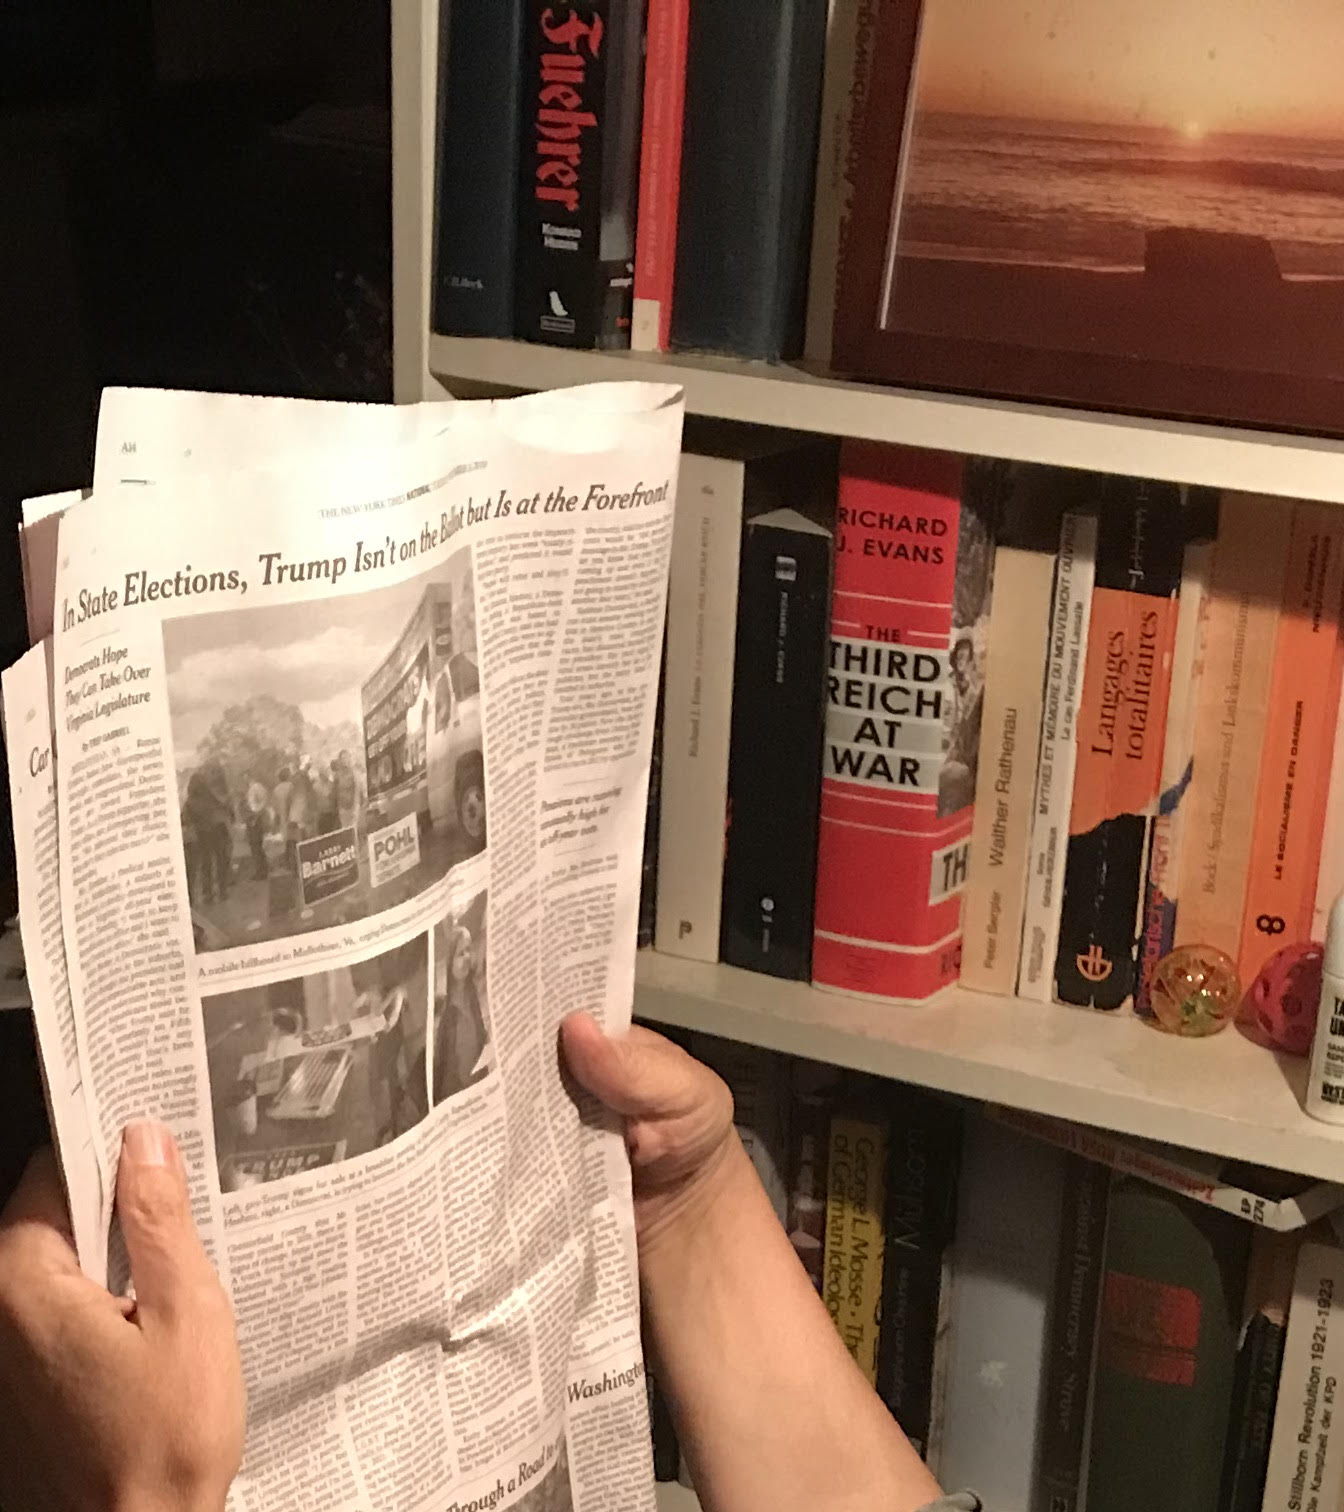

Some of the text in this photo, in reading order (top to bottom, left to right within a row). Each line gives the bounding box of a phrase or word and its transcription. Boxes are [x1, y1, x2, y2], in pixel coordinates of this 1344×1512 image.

[535, 8, 604, 213] Fuehrer
[838, 506, 948, 538] RICHARD
[61, 479, 670, 633] In State Elections, Trump Isn't on the but Is at the Forefront
[836, 535, 945, 566] J. EVANS
[865, 624, 902, 643] THE
[1048, 573, 1074, 659] MOUVEMENT
[99, 670, 122, 691] Take
[122, 665, 152, 683] Over
[102, 646, 129, 665] Hope
[828, 639, 941, 683] THIRD
[1050, 659, 1064, 682] DU
[1061, 647, 1081, 703] Ferdinand
[95, 690, 152, 719] Legislature
[828, 678, 942, 720] REICH
[1089, 628, 1133, 758] Langages
[1115, 607, 1161, 761] totalitaires
[853, 716, 903, 750] AT
[992, 705, 1019, 795] Rathenau
[1043, 743, 1056, 762] ET
[830, 744, 921, 787] WAR
[1036, 762, 1055, 816] MYTHES
[1273, 781, 1297, 862] SOCIALISME
[1286, 698, 1306, 757] DANGER
[372, 823, 416, 863] POHL
[985, 799, 1010, 868] Walther
[301, 845, 356, 879] Barnett
[826, 1133, 852, 1249] of German
[846, 1135, 877, 1308] George Mosse
[1306, 1276, 1338, 1362] 1921-1923
[1295, 1363, 1324, 1446] Revolution
[1320, 1374, 1339, 1405] KPD
[1318, 1407, 1333, 1430] der
[507, 1478, 516, 1493] a
[518, 1444, 545, 1487] Road
[1284, 1447, 1312, 1512] Stillborn
[1308, 1432, 1331, 1493] Kampfzeit
